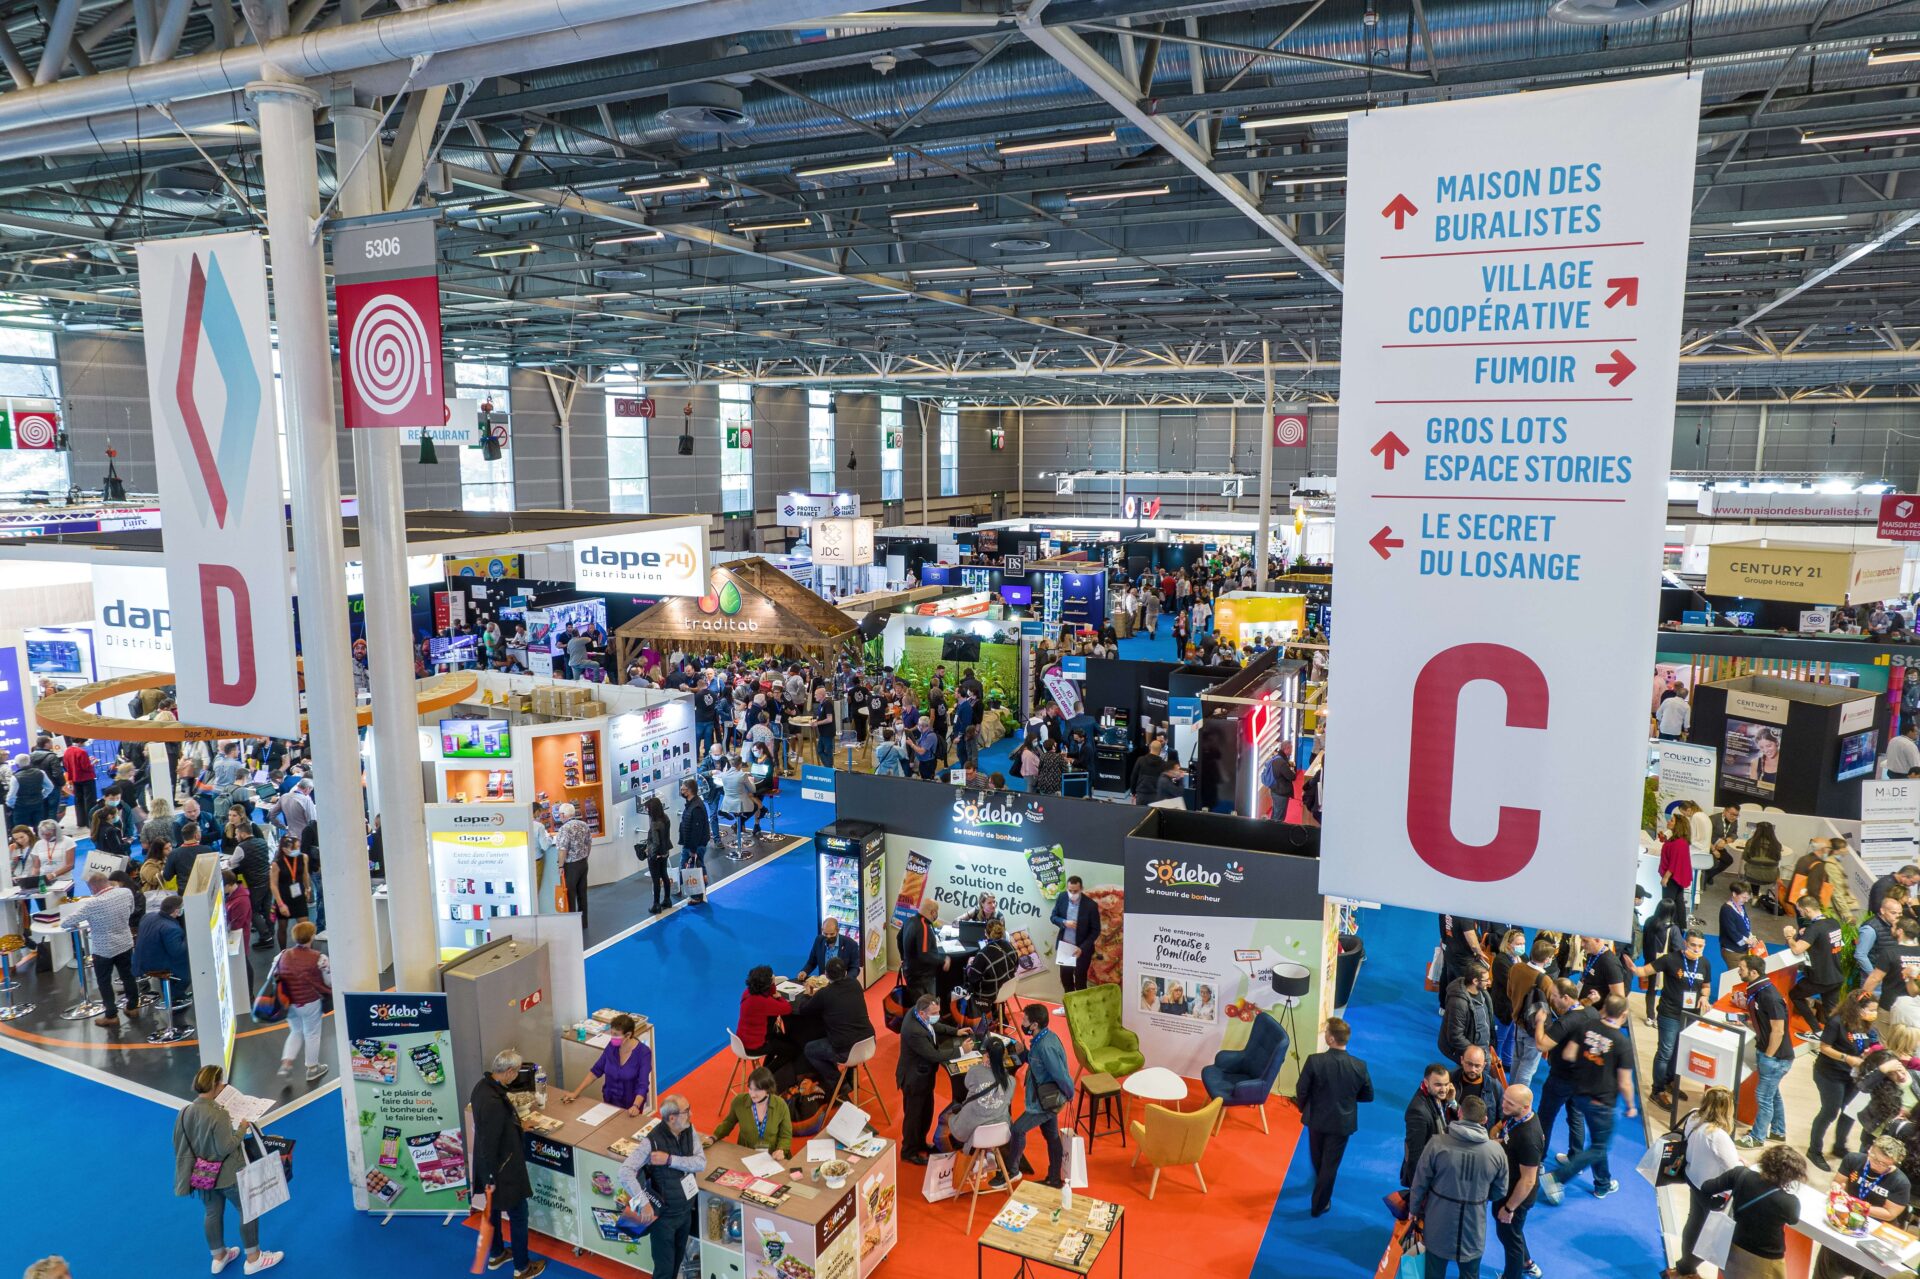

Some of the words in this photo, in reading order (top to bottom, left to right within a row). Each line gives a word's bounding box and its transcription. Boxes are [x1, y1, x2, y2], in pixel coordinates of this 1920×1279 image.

[1437, 168, 1540, 203] MAISON
[1549, 163, 1602, 195] DES
[1435, 204, 1602, 242] BURALISTES
[365, 237, 400, 258] 5306
[1482, 260, 1594, 292] VILLAGE
[1408, 298, 1592, 333] COOPÉRATIVE
[1475, 356, 1576, 384] FUMOIR
[1426, 417, 1494, 444] GROS
[1501, 417, 1568, 444] LOTS
[1425, 455, 1519, 482] ESPACE
[1525, 455, 1632, 483] STORIES
[1712, 506, 1872, 518] www.maisondesburalistes.fr
[1421, 513, 1450, 539] LE
[1457, 514, 1556, 542] SECRET
[580, 546, 661, 577] dape
[820, 547, 840, 556] JDC
[582, 569, 663, 581] Distribution
[1420, 550, 1453, 577] DU
[1460, 551, 1580, 581] LOSANGE
[1730, 562, 1804, 577] CENTURY
[1807, 567, 1822, 578] 21
[1744, 576, 1773, 586] Groupe
[1775, 579, 1804, 587] Horeca
[198, 563, 257, 707] D
[685, 617, 758, 632] traditab
[1407, 642, 1549, 882] C
[453, 815, 490, 825] dape
[952, 800, 1023, 826] Sodebo
[953, 826, 962, 835] Se
[963, 829, 985, 838] nourrir
[986, 831, 994, 839] de
[995, 833, 1023, 842] bonheur
[971, 863, 1007, 877] votre
[1144, 858, 1222, 887] Sodebo
[950, 874, 1004, 892] solution
[1007, 881, 1024, 895] de
[1146, 887, 1155, 895] Se
[1156, 888, 1180, 898] nourrir
[1180, 891, 1190, 899] de
[1191, 892, 1220, 903] bonheur
[1153, 934, 1203, 950] Française
[1204, 942, 1210, 951] &
[1173, 929, 1205, 938] entreprise
[369, 1003, 419, 1020] Sodebo
[394, 1090, 419, 1098] plaisir
[531, 1140, 561, 1158] Sodebo
